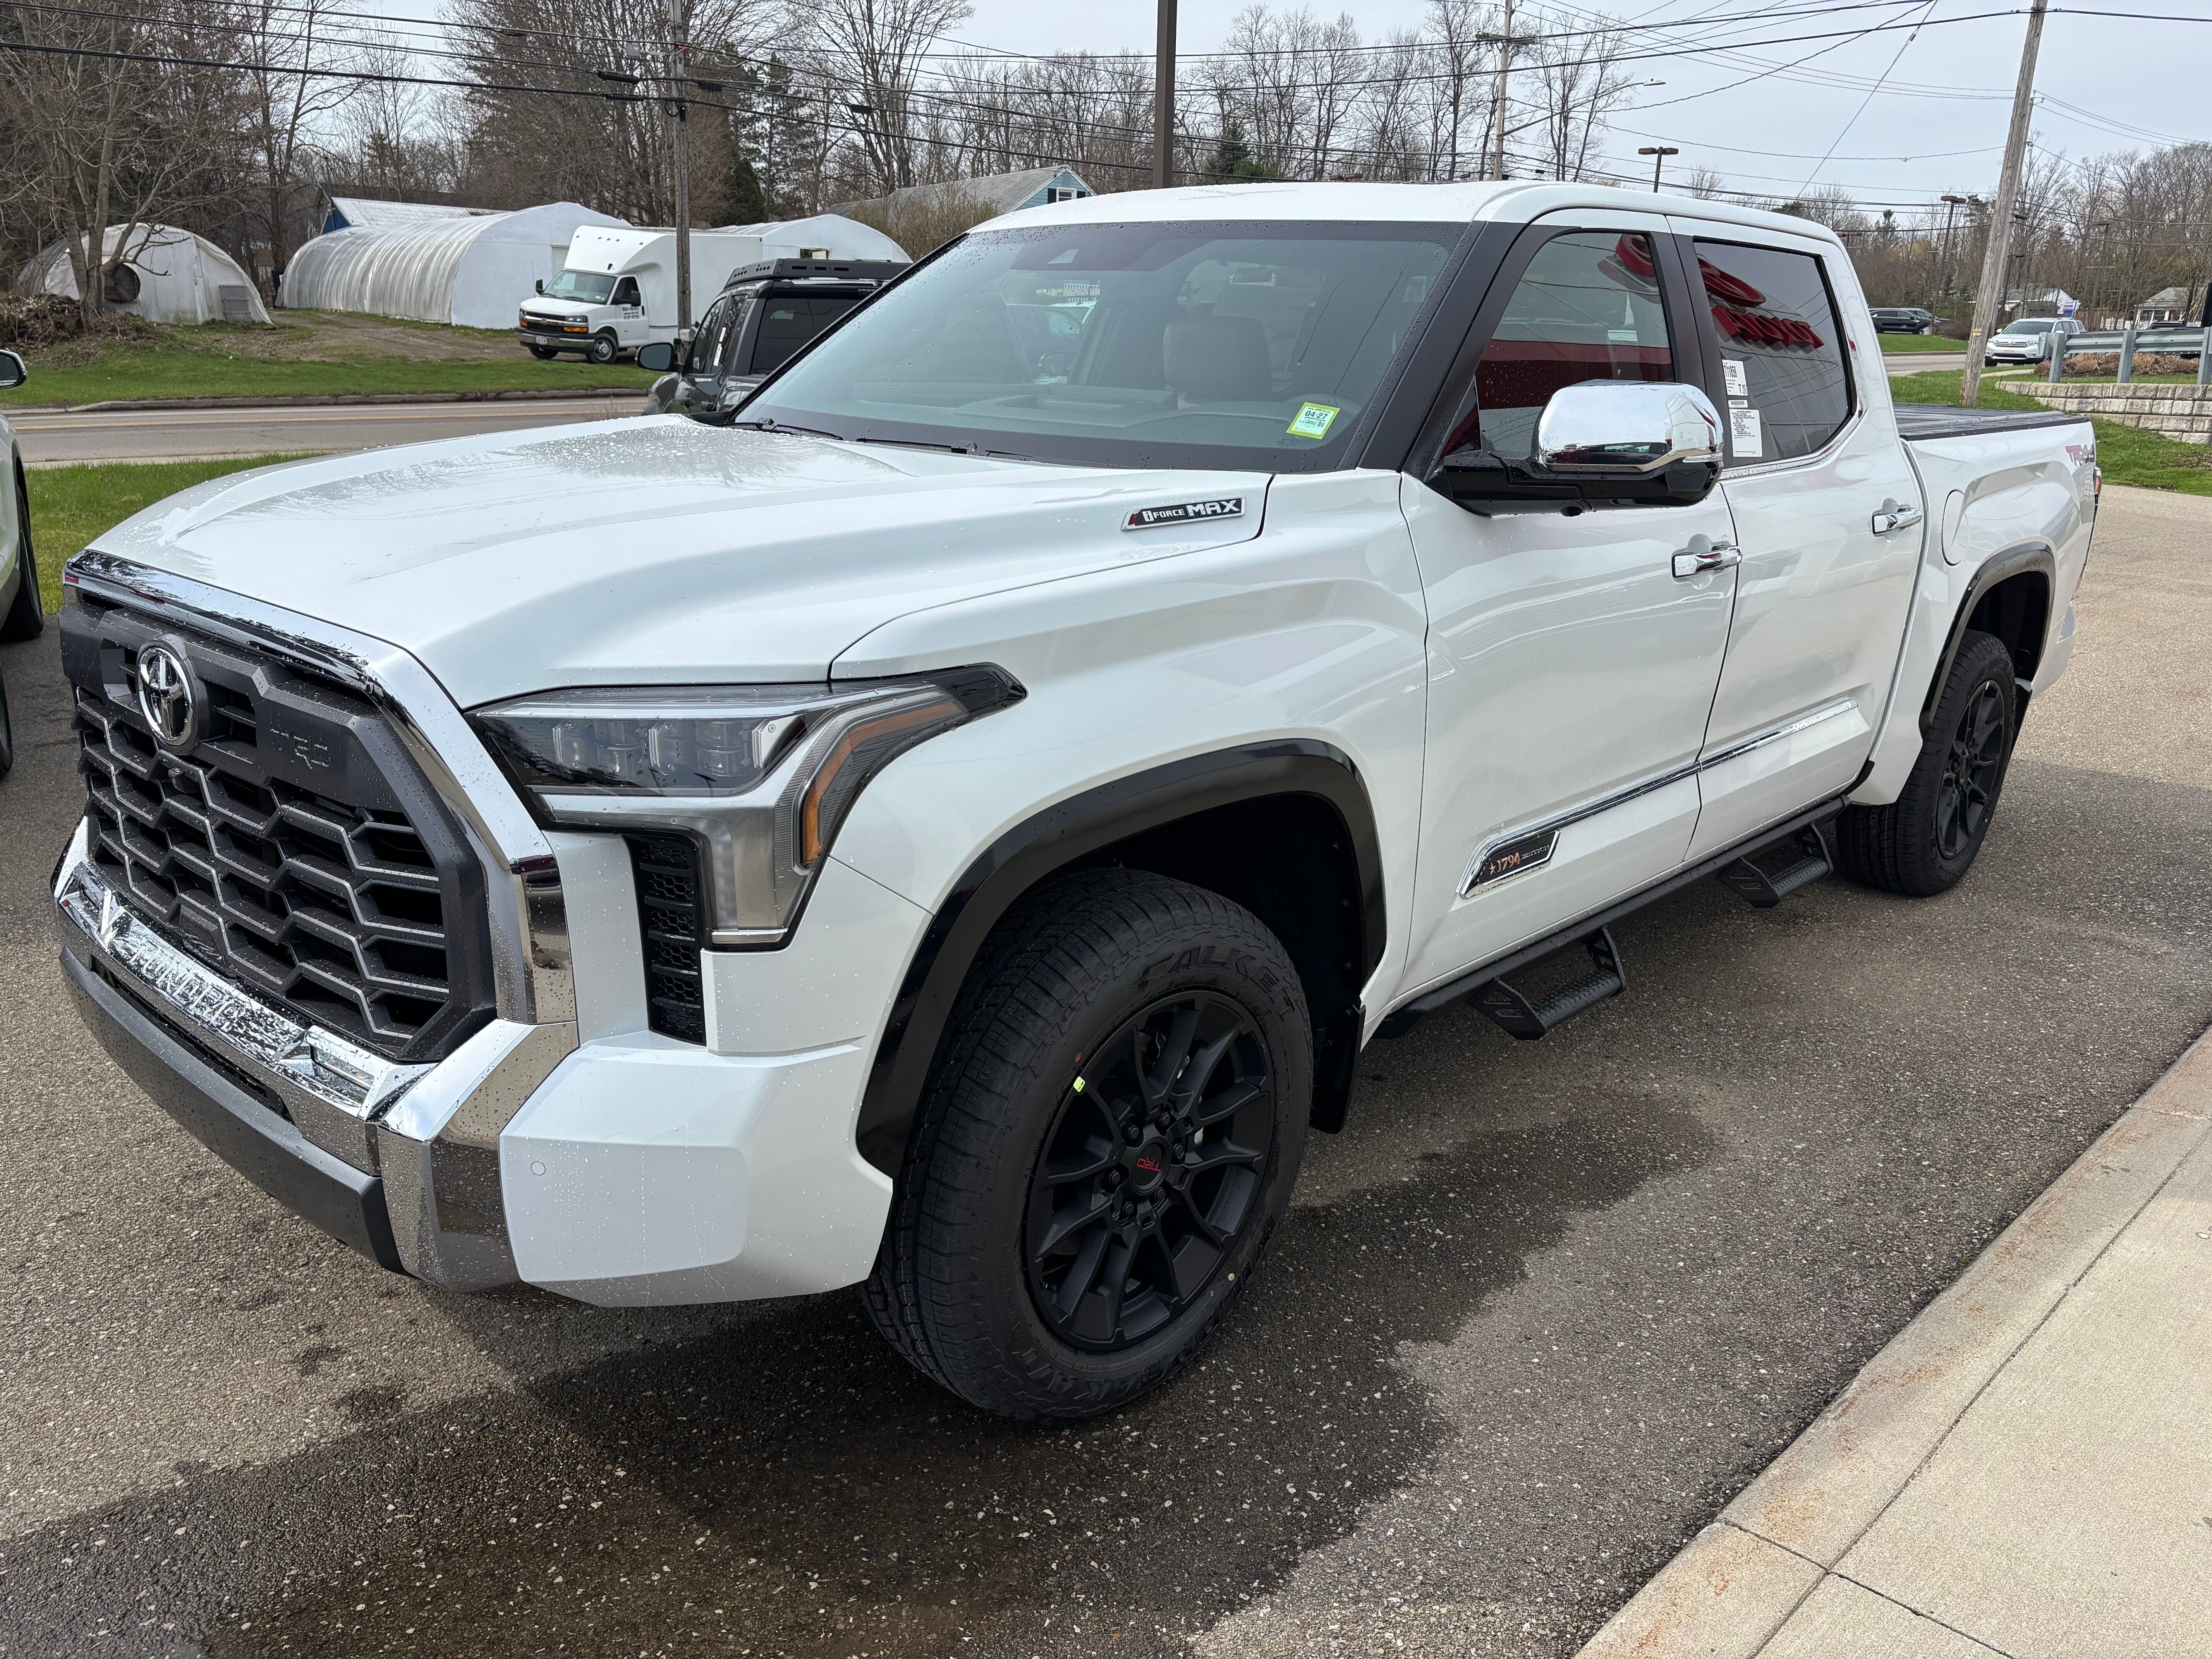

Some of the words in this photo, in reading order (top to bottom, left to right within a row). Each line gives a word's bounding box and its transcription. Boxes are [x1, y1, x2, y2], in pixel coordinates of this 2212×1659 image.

[1305, 410, 1328, 420] 04-27
[1186, 500, 1240, 517] MAX
[1497, 852, 1521, 872] 1794
[1522, 845, 1550, 859] EDITION
[129, 938, 238, 1032] TUNDRA
[1132, 945, 1295, 1022] FALKEN
[1137, 1157, 1161, 1172] TRD
